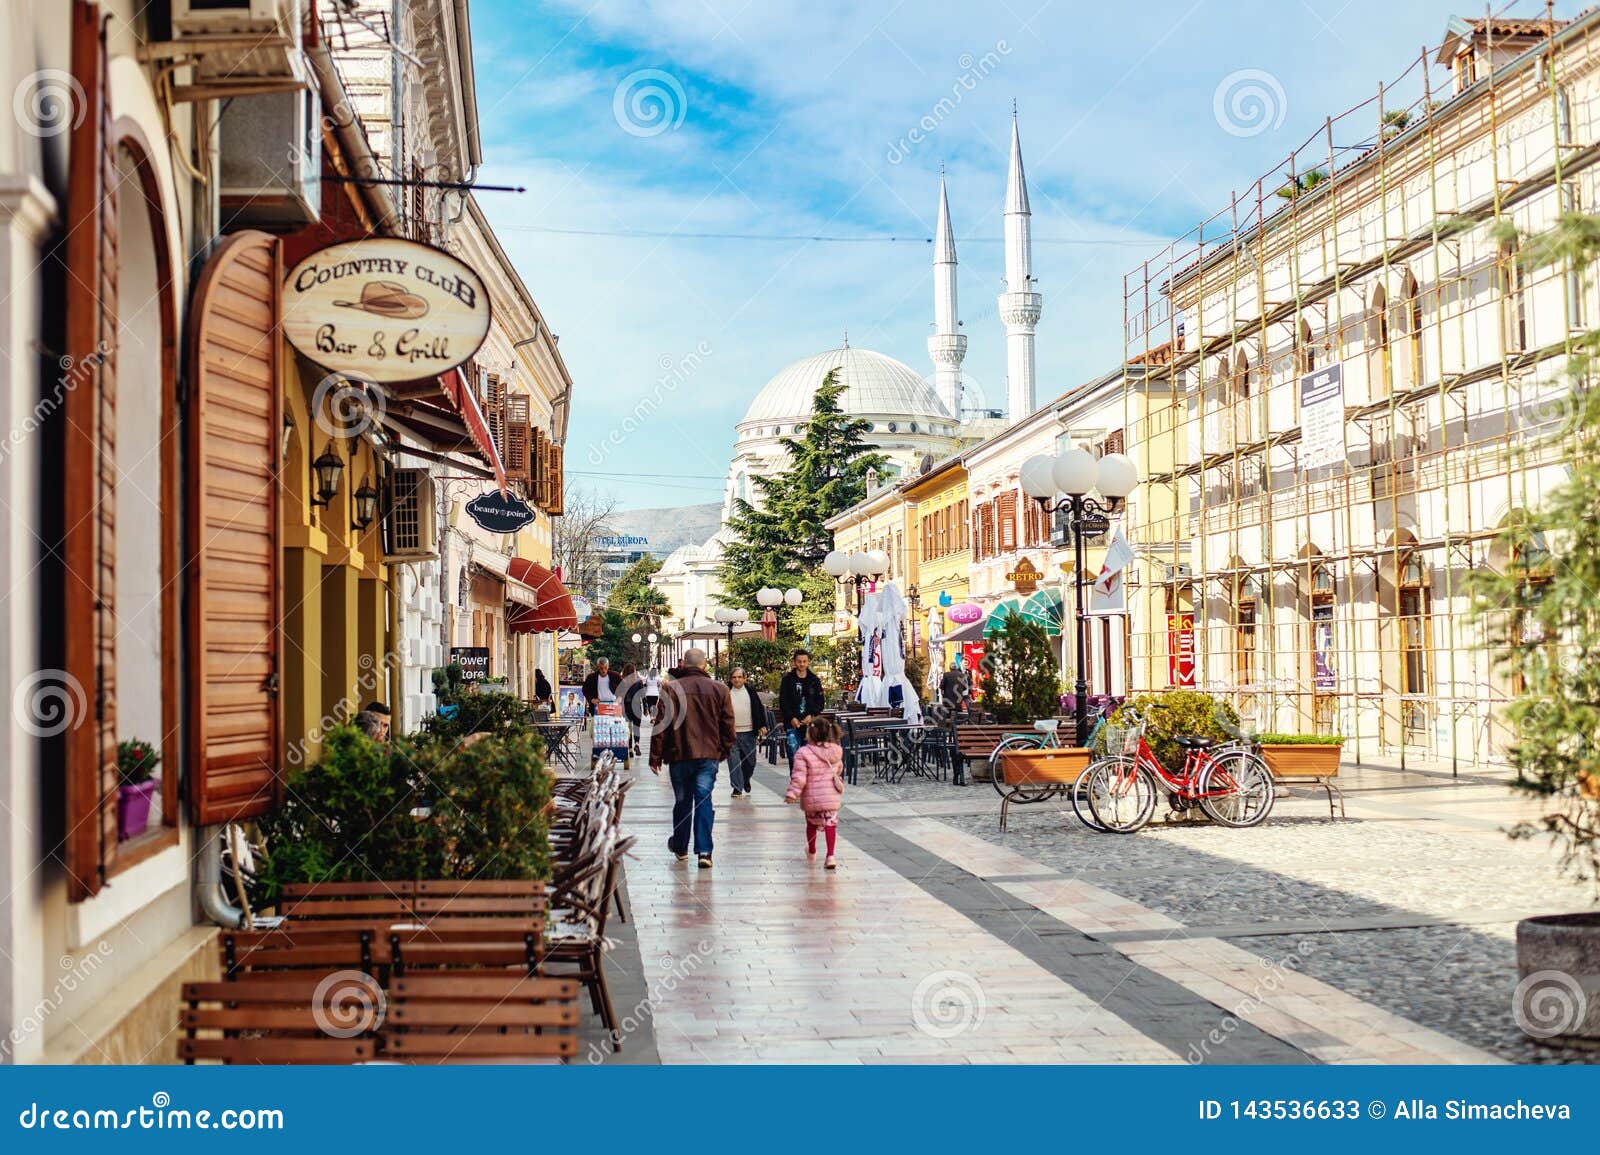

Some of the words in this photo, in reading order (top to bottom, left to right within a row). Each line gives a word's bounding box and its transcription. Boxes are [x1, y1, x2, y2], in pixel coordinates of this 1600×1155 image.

[294, 257, 410, 293] COUNTRY
[315, 323, 357, 354] Bar
[367, 330, 386, 361] &
[395, 328, 451, 363] Grill
[474, 503, 499, 515] beauty
[616, 535, 648, 545] EUROPA
[1009, 572, 1042, 581] RETRO
[451, 653, 489, 666] Flower
[461, 669, 484, 680] tore
